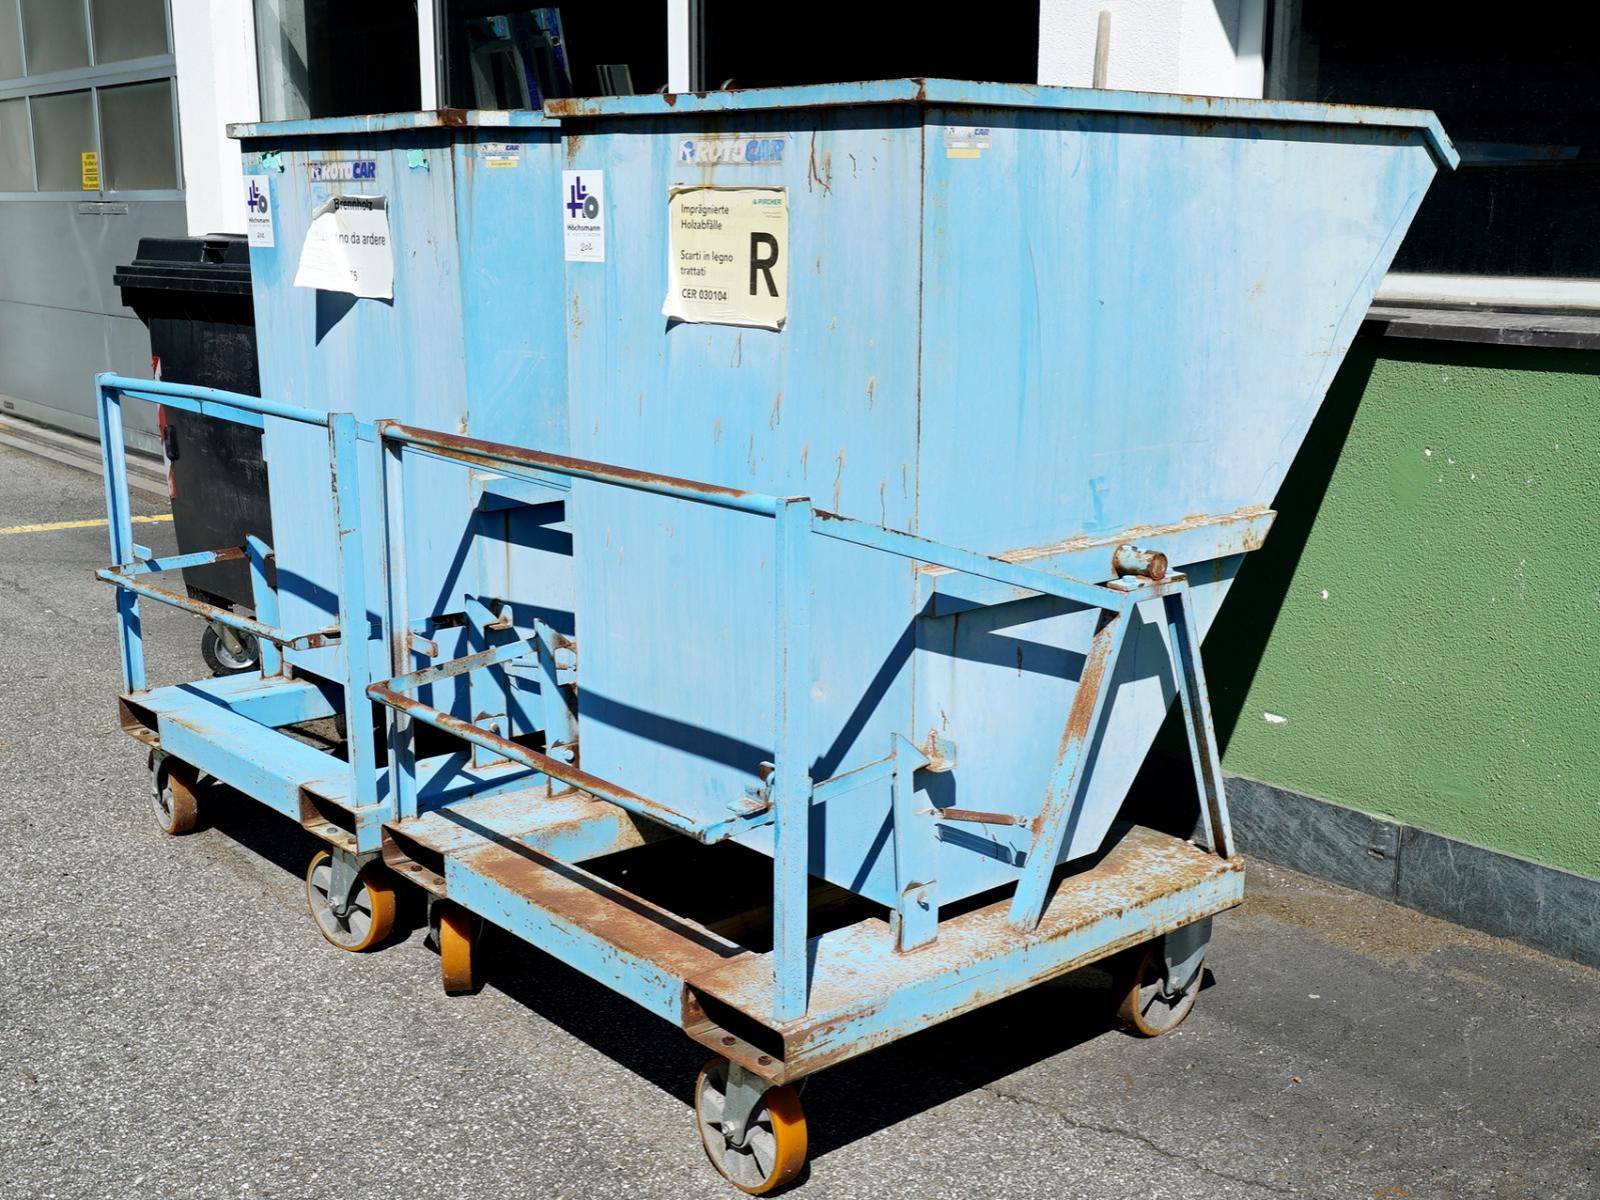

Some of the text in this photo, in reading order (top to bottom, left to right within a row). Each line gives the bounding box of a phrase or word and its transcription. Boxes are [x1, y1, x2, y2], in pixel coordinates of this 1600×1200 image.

[333, 198, 373, 211] Brennholz
[680, 204, 729, 217] Imprägnierte
[567, 224, 601, 232] Höchsmann
[680, 219, 722, 231] Holzabfälle
[350, 232, 360, 244] da
[362, 233, 386, 246] ardere
[680, 249, 734, 265] Scarti in legno
[680, 266, 706, 277] trattati
[749, 232, 779, 298] R
[681, 288, 728, 301] CER 030104
